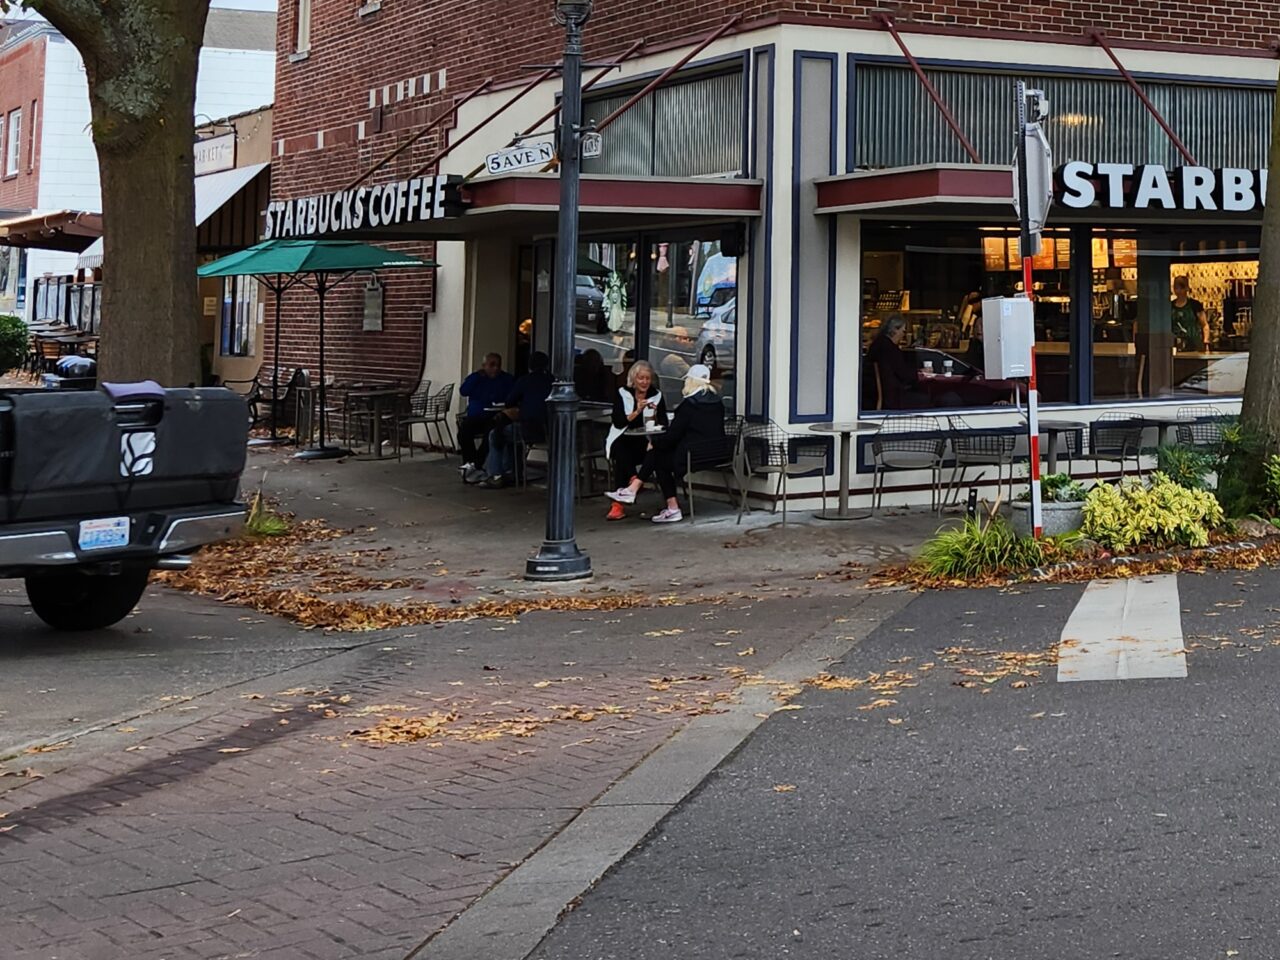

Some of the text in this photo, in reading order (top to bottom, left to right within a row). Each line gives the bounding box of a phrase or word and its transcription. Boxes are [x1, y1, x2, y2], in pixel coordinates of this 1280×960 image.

[490, 147, 552, 170] 5 AVE N
[264, 173, 448, 240] STARBUCKS COFFEE
